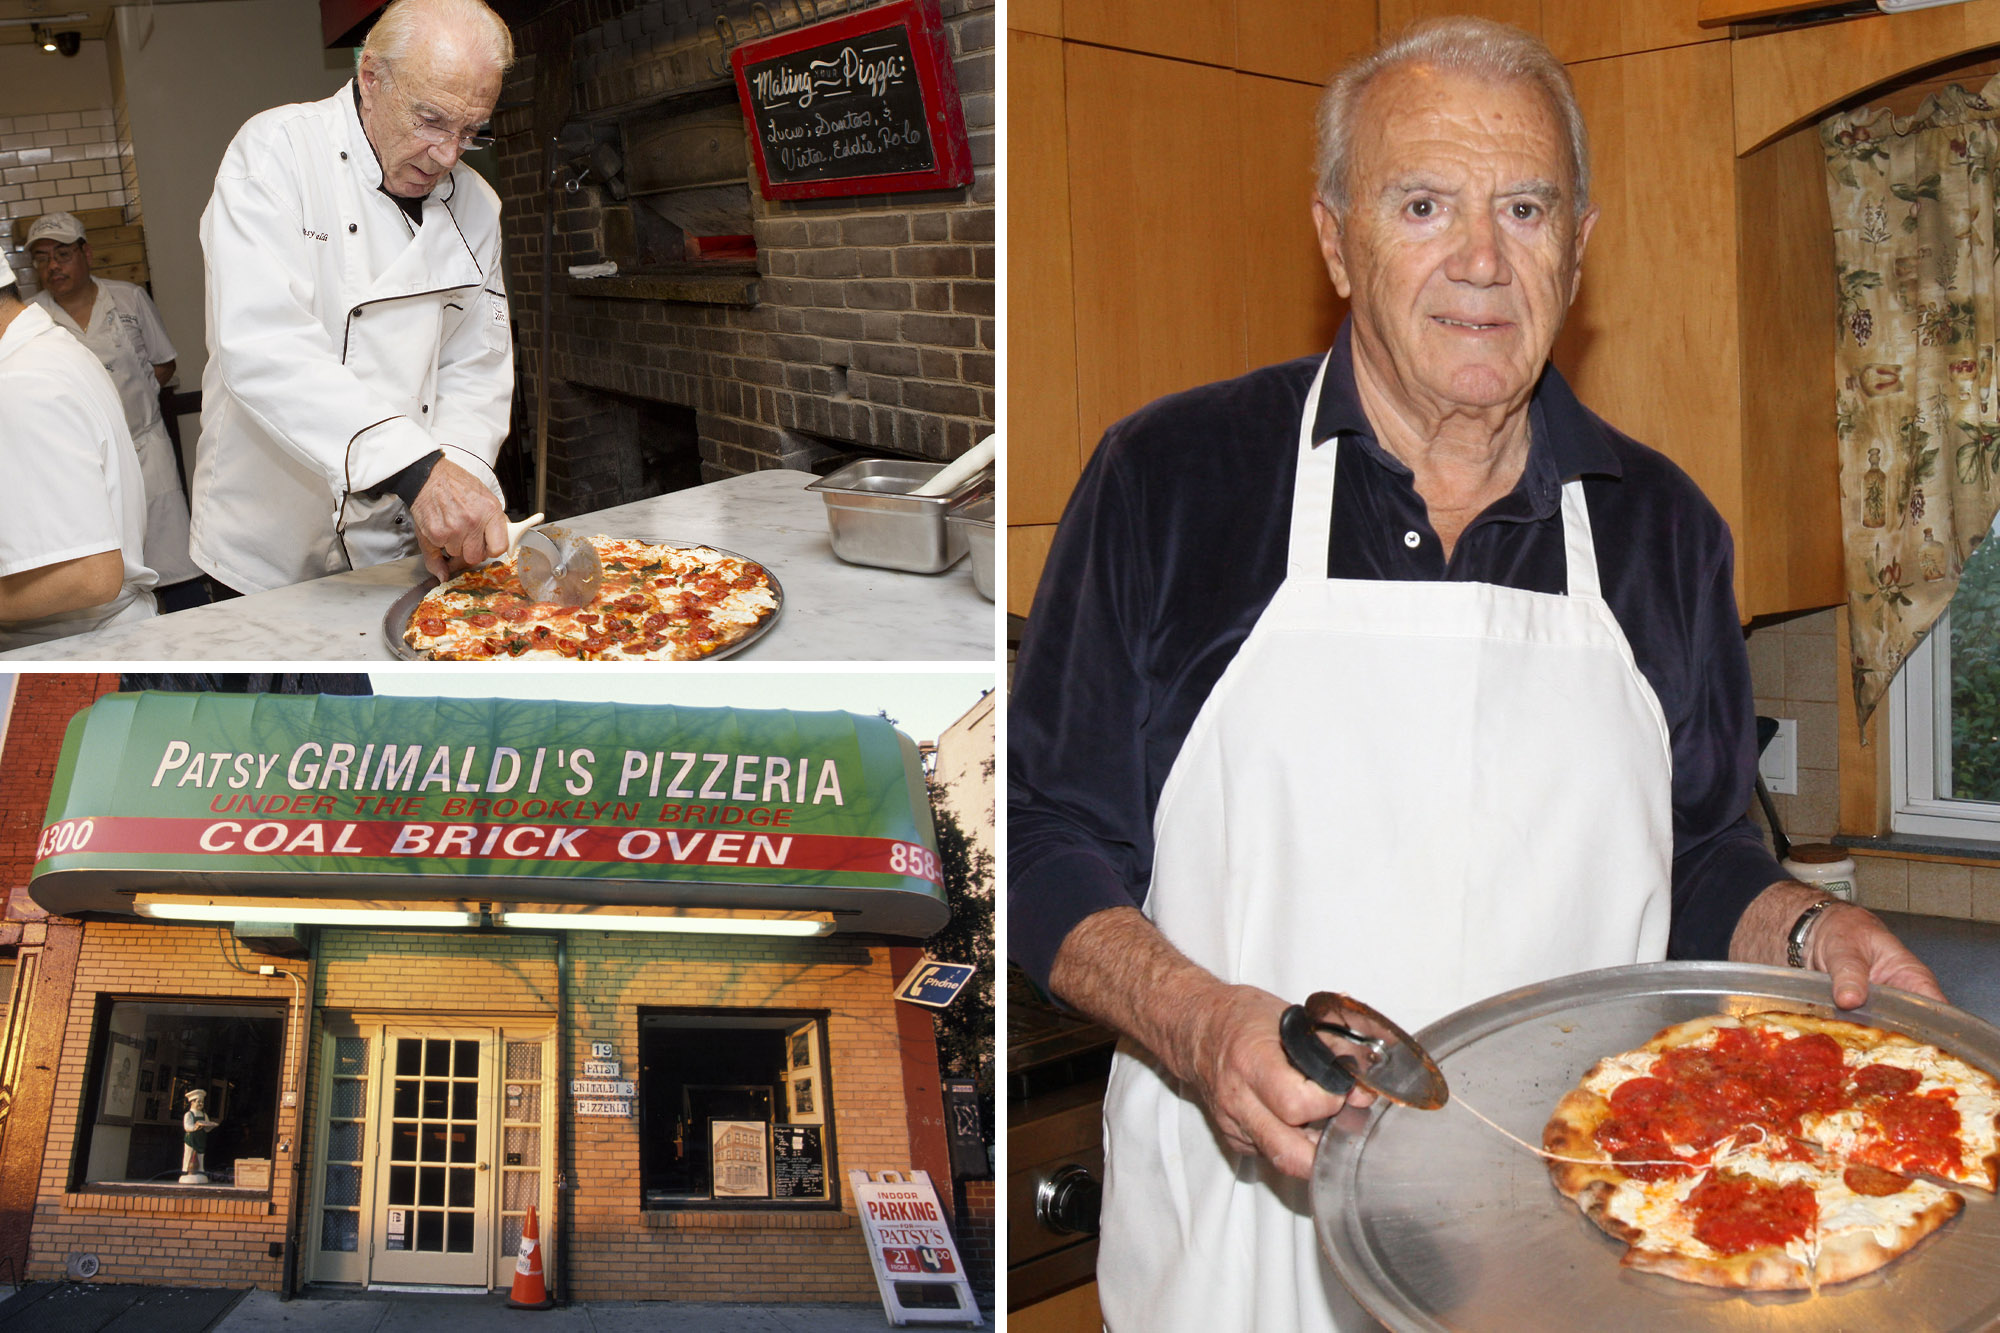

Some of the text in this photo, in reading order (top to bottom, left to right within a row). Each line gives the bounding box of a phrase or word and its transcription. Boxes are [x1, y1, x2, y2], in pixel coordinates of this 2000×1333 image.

[753, 66, 818, 108] Making
[152, 740, 280, 790] PATSY
[618, 750, 845, 807] PIZZERIA
[209, 794, 795, 828] UNDER THE BROOKLYN BRIDGE
[200, 821, 794, 866] COAL BRICK OVEN
[924, 977, 960, 990] Phone
[594, 1045, 611, 1056] 19
[587, 1064, 617, 1074] PATSY
[579, 1102, 628, 1113] PIZZERIA
[867, 1201, 938, 1222] PARKING
[878, 1228, 945, 1245] PATSY'S
[892, 1249, 910, 1264] 21
